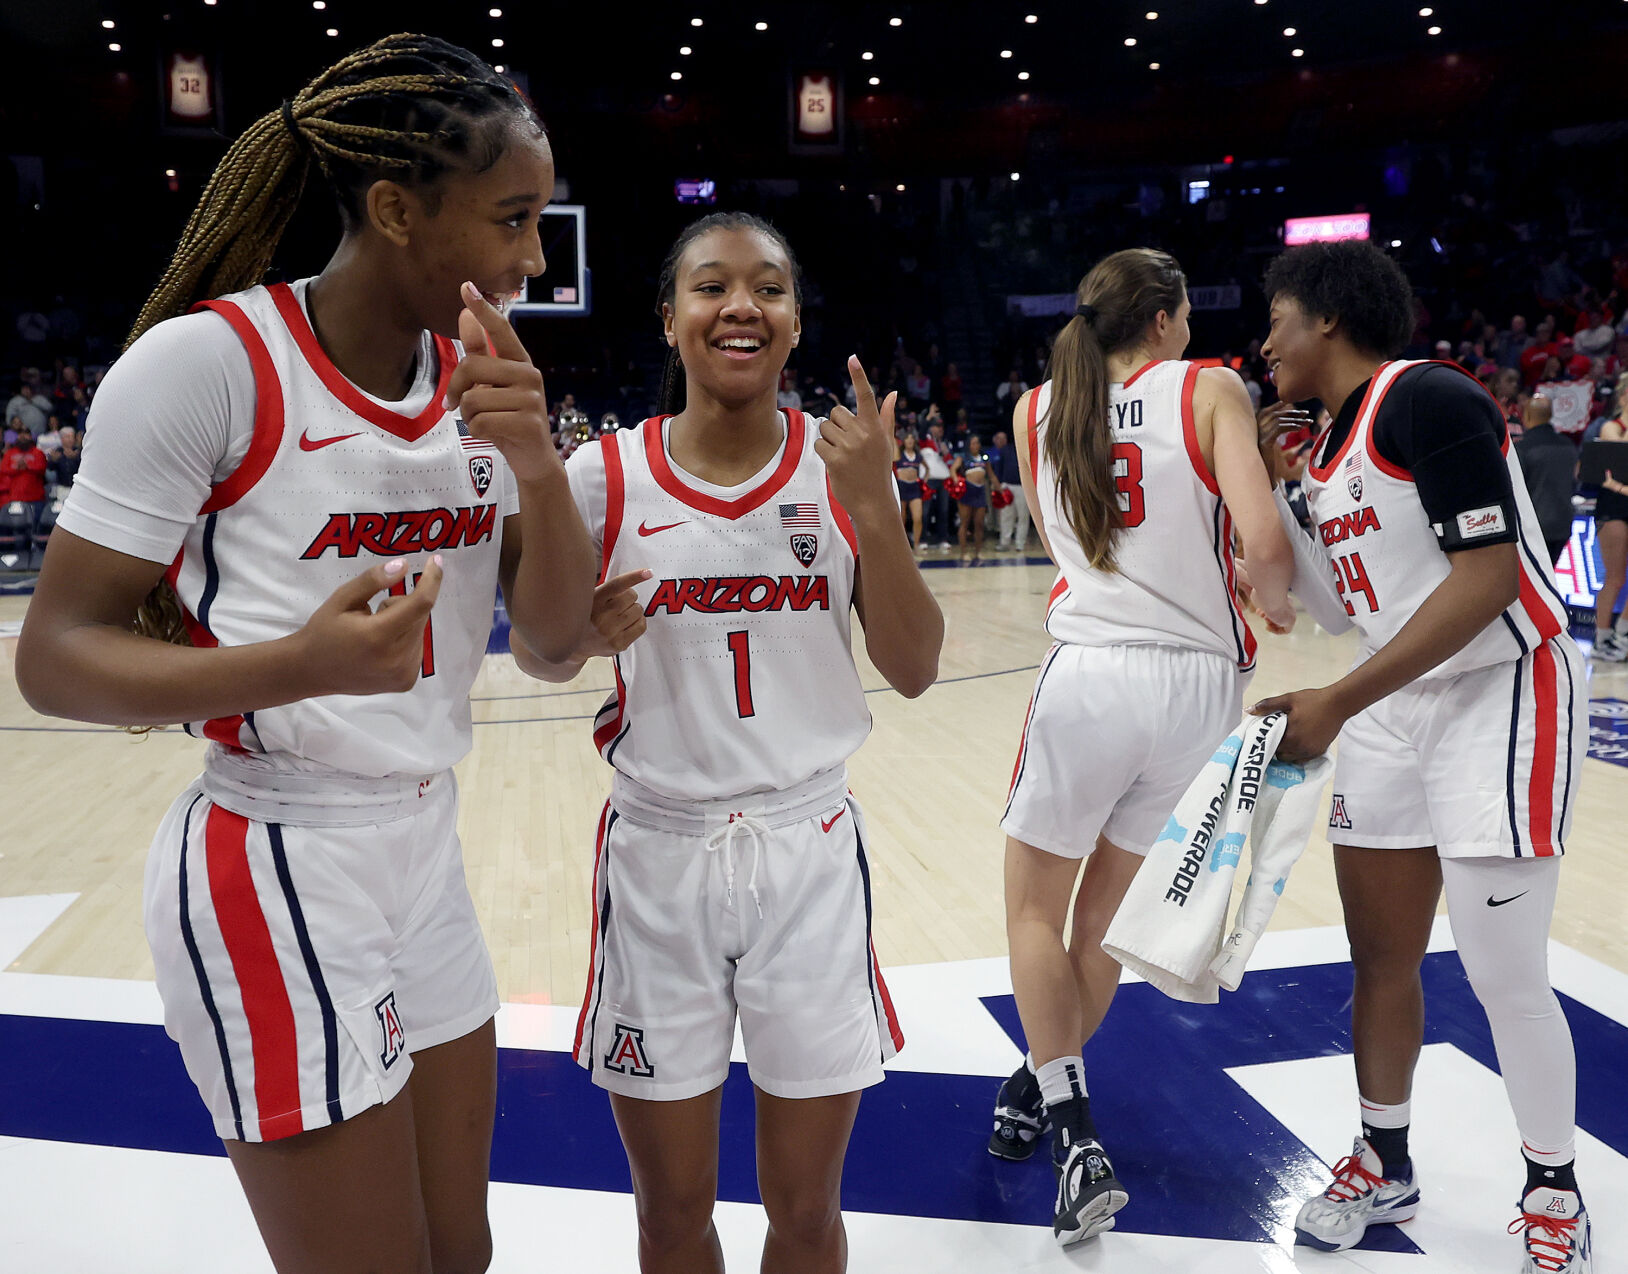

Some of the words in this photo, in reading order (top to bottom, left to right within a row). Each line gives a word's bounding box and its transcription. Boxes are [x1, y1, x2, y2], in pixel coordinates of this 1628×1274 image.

[180, 78, 200, 93] 32
[808, 98, 825, 112] 25
[298, 502, 497, 560] ARIZONA
[799, 548, 812, 560] 12
[643, 575, 830, 617] ARIZONA
[727, 630, 755, 718] 1
[1329, 794, 1352, 829] A
[375, 991, 405, 1071] A
[604, 1023, 654, 1078] A
[1546, 1197, 1566, 1213] A
